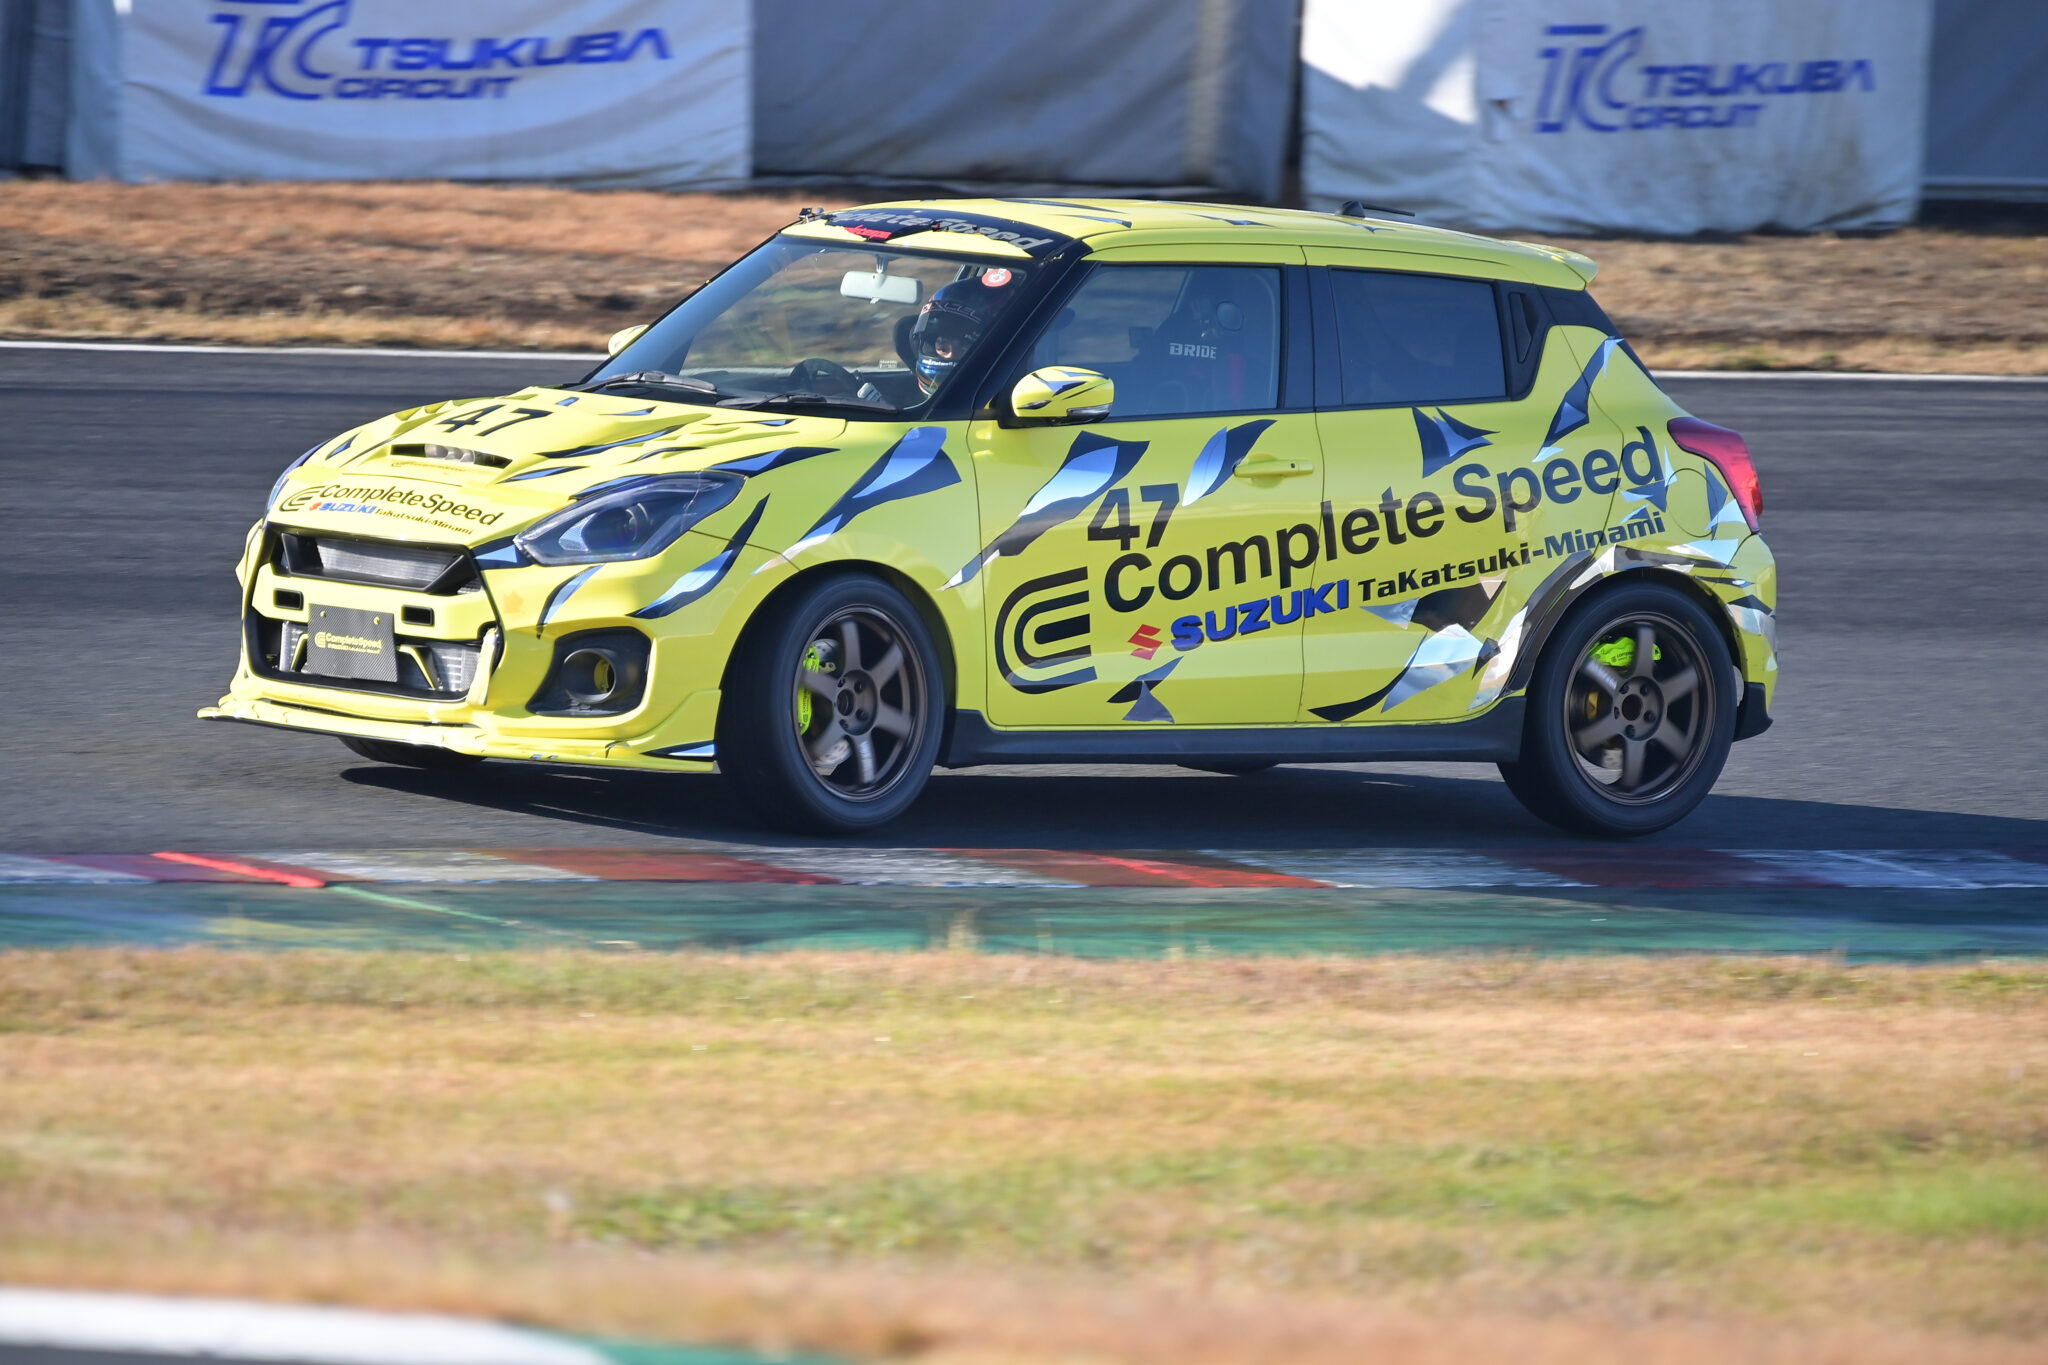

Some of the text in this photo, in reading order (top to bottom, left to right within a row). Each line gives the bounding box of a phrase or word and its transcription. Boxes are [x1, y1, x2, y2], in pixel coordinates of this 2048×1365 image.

[352, 28, 673, 70] TSUKUBA
[334, 76, 517, 98] CIRCUIT
[1640, 59, 1876, 97] TSUKUBA
[1630, 104, 1767, 130] CIRCUIT
[1169, 342, 1217, 359] BRIDE
[434, 404, 555, 437] 47
[320, 502, 377, 514] SUZUKI
[1087, 482, 1180, 551] 47
[1170, 579, 1350, 652] SUZUKI
